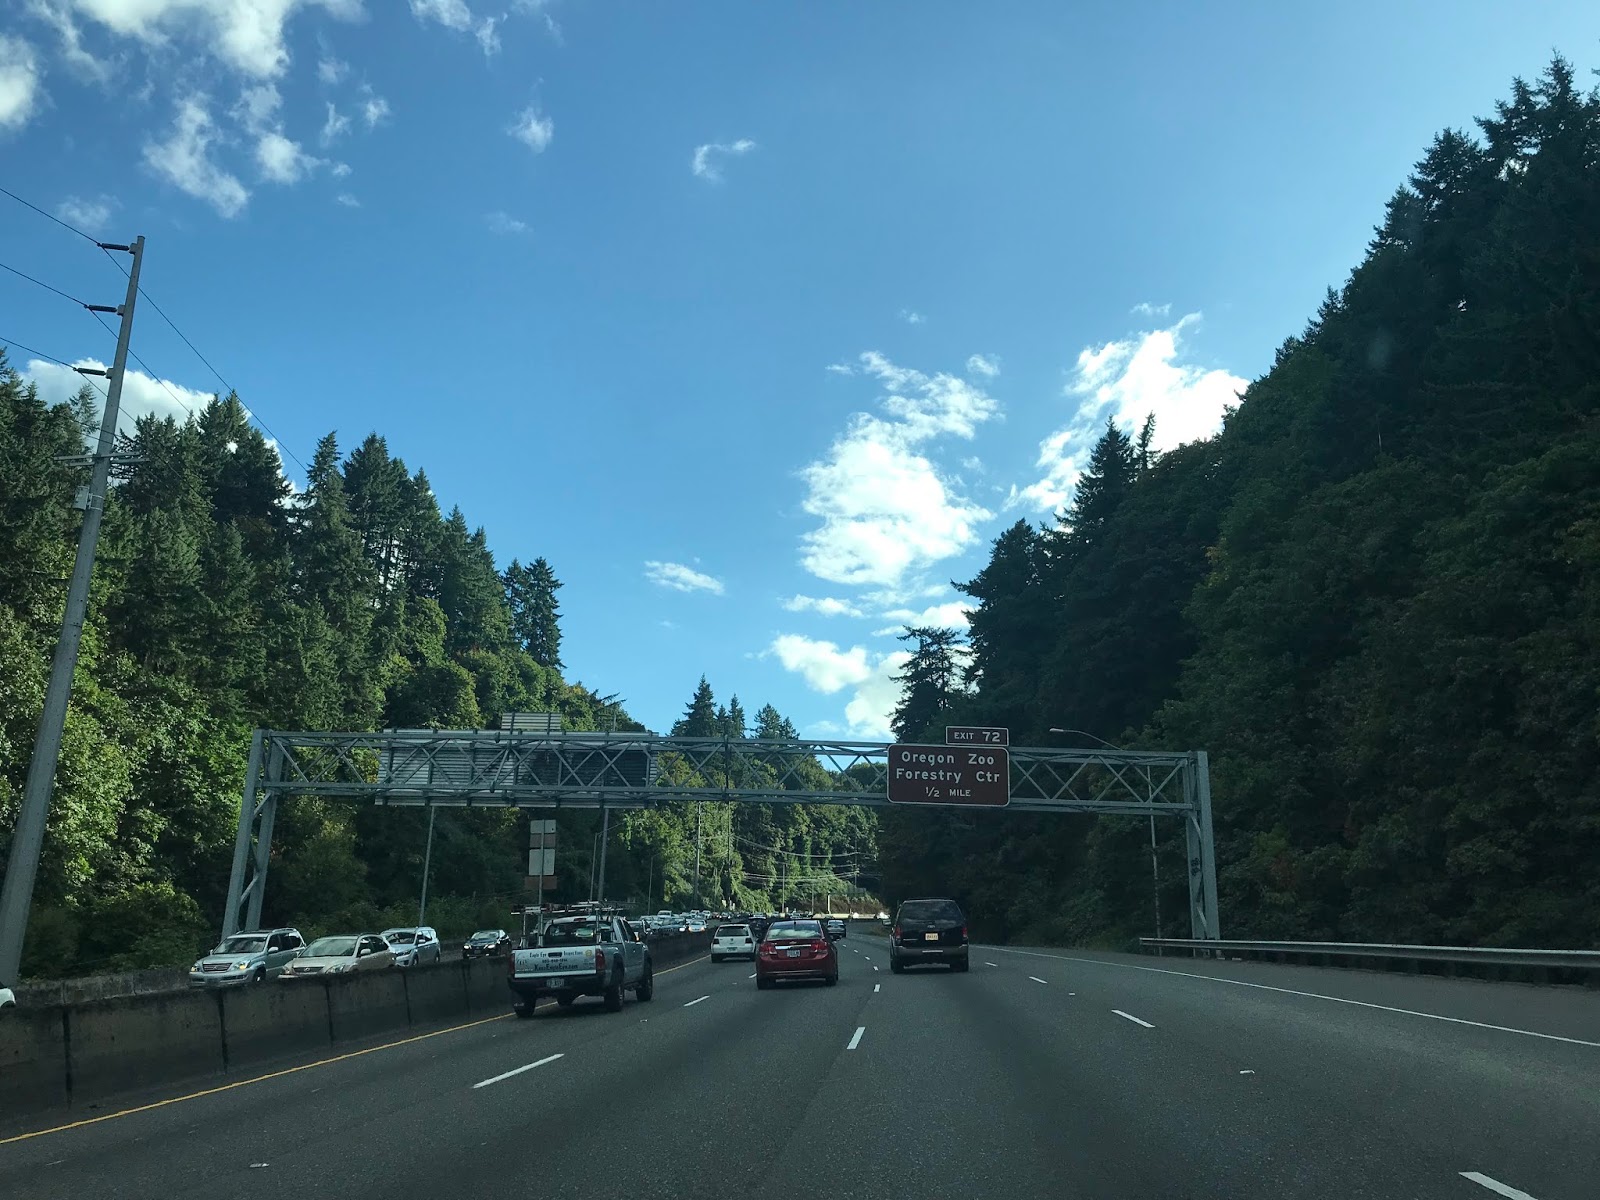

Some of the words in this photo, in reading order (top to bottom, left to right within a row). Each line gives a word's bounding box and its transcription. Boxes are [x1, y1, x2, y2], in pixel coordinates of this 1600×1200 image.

[954, 732, 974, 740] EXIT
[982, 731, 1000, 742] 72
[901, 751, 954, 767] Oregon
[968, 753, 994, 765] Zoo
[896, 768, 961, 783] Forestry
[976, 771, 1000, 782] Ctr
[949, 789, 971, 797] MILE
